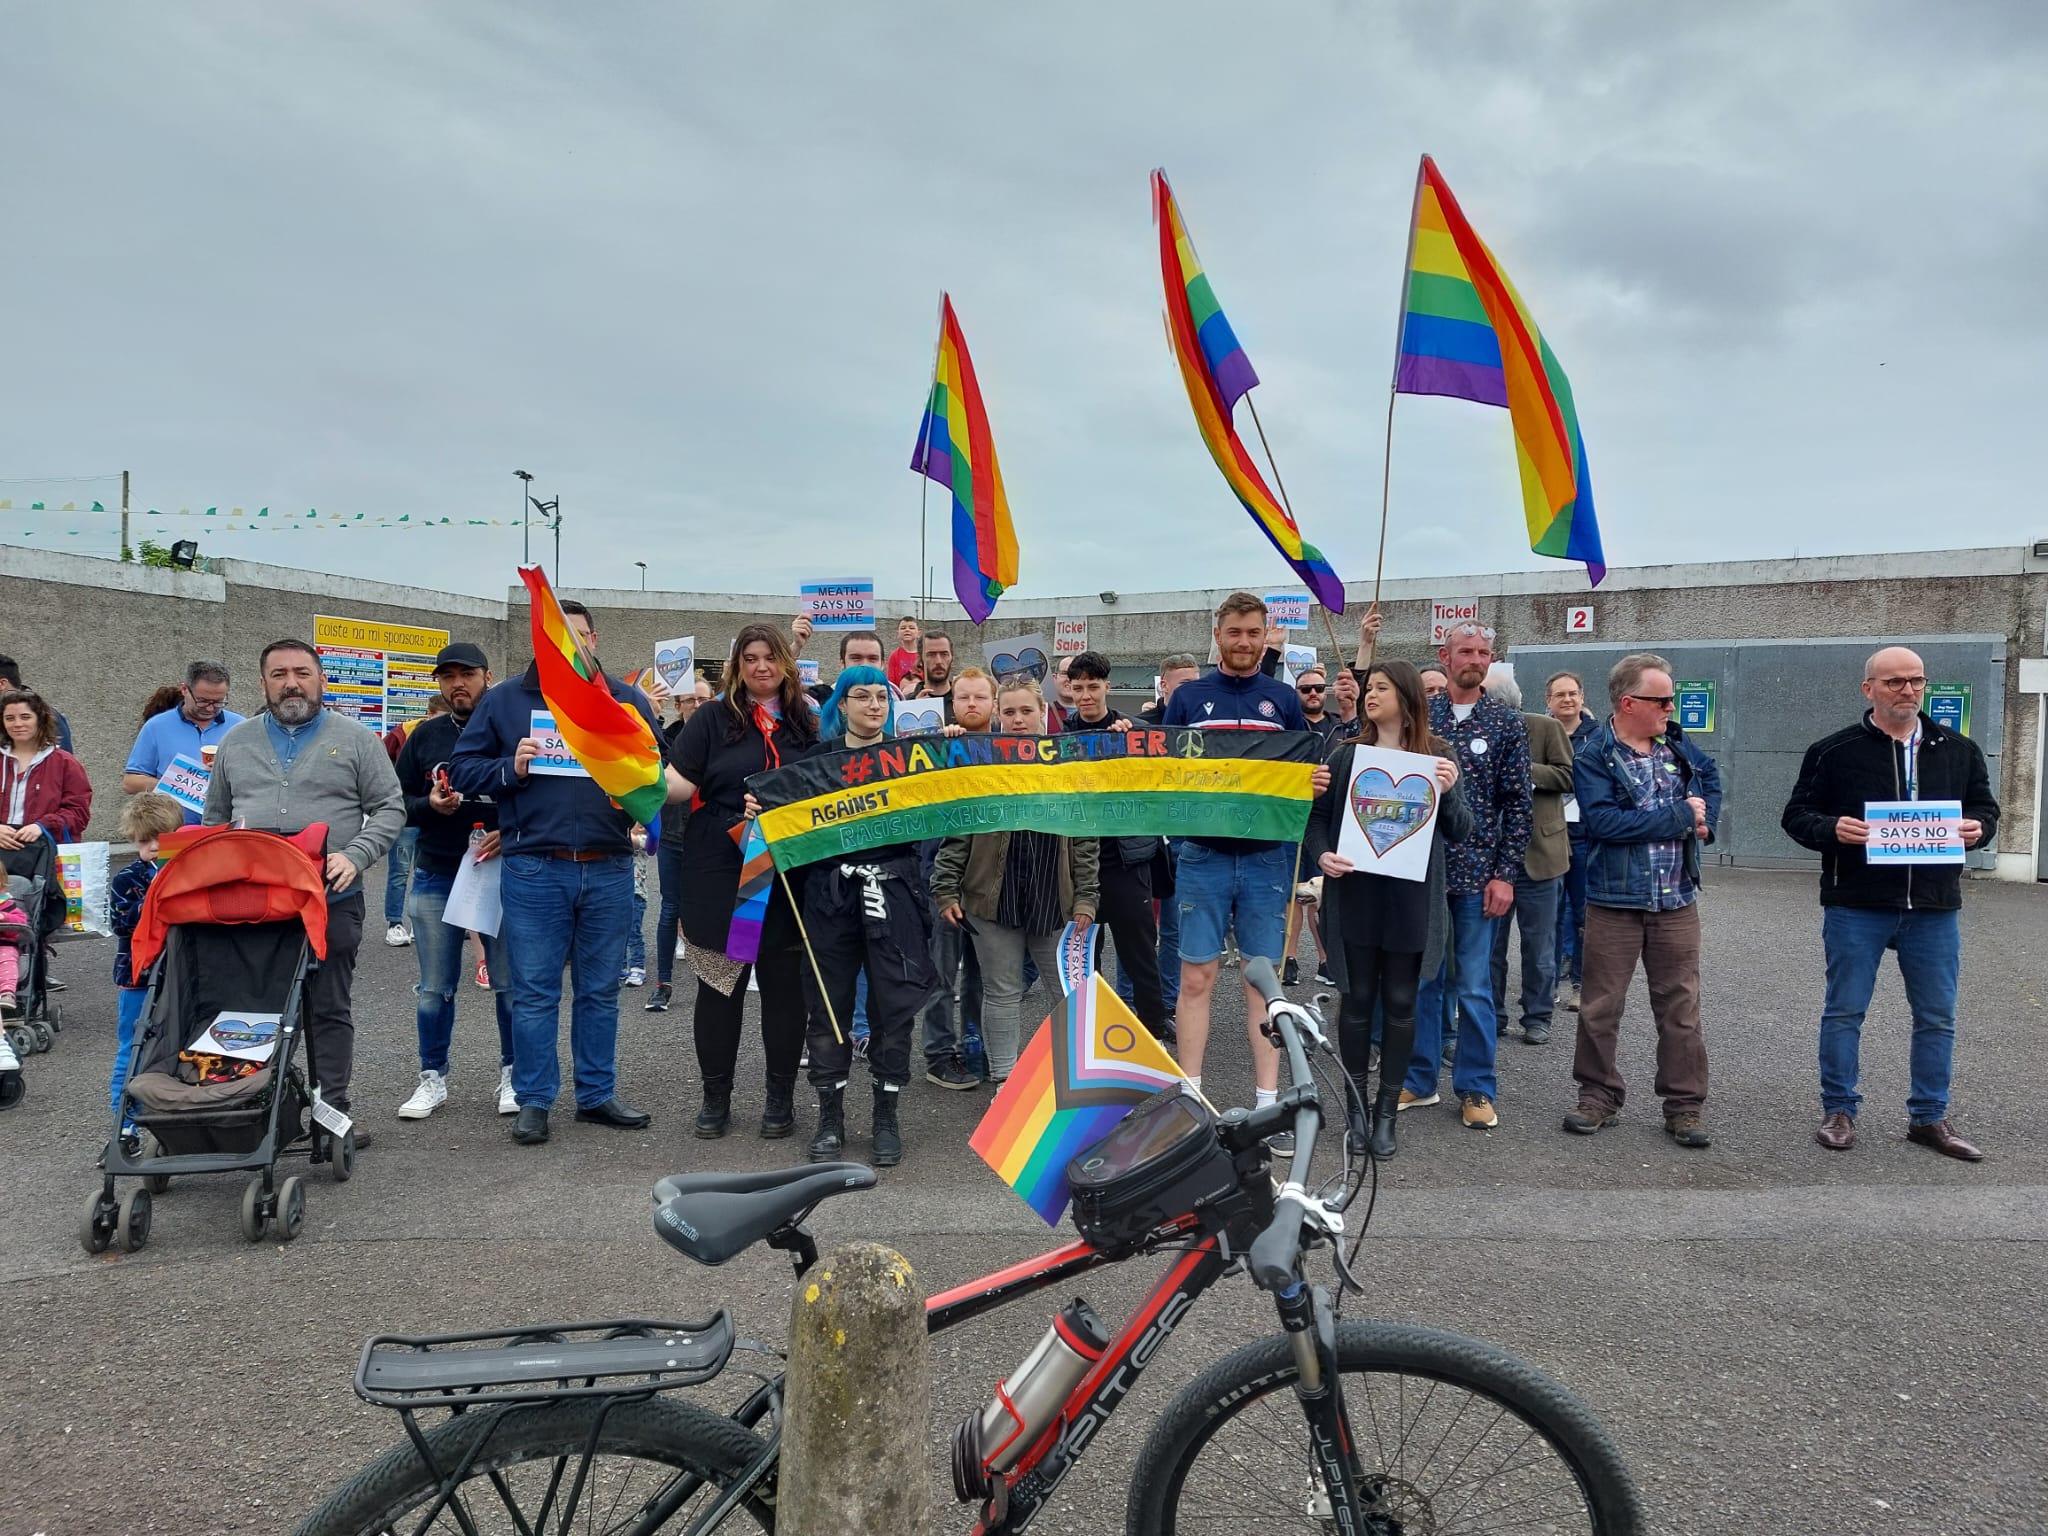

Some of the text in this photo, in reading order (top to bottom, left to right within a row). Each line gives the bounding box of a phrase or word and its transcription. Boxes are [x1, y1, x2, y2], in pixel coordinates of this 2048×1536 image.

[818, 587, 858, 596] MEATH
[812, 600, 864, 610] SAYS NO
[1433, 603, 1477, 619] Ticket
[813, 613, 864, 622] TO HATE
[1573, 610, 1587, 628] 2
[352, 626, 365, 641] na
[1056, 620, 1087, 634] Ticket
[1056, 638, 1086, 652] Sales
[545, 738, 565, 750] SA
[544, 753, 564, 765] TO
[186, 766, 209, 782] MEA
[169, 783, 184, 796] TO
[174, 774, 204, 792] SAYS
[810, 788, 889, 827] AGAINST
[1102, 799, 1148, 821] AND
[1889, 811, 1941, 823] MEATH
[1880, 826, 1948, 838] SAYS NO
[1881, 842, 1947, 853] TO HATE
[1073, 933, 1081, 952] NO
[1063, 937, 1072, 980] MEATH
[1081, 935, 1090, 970] HATE
